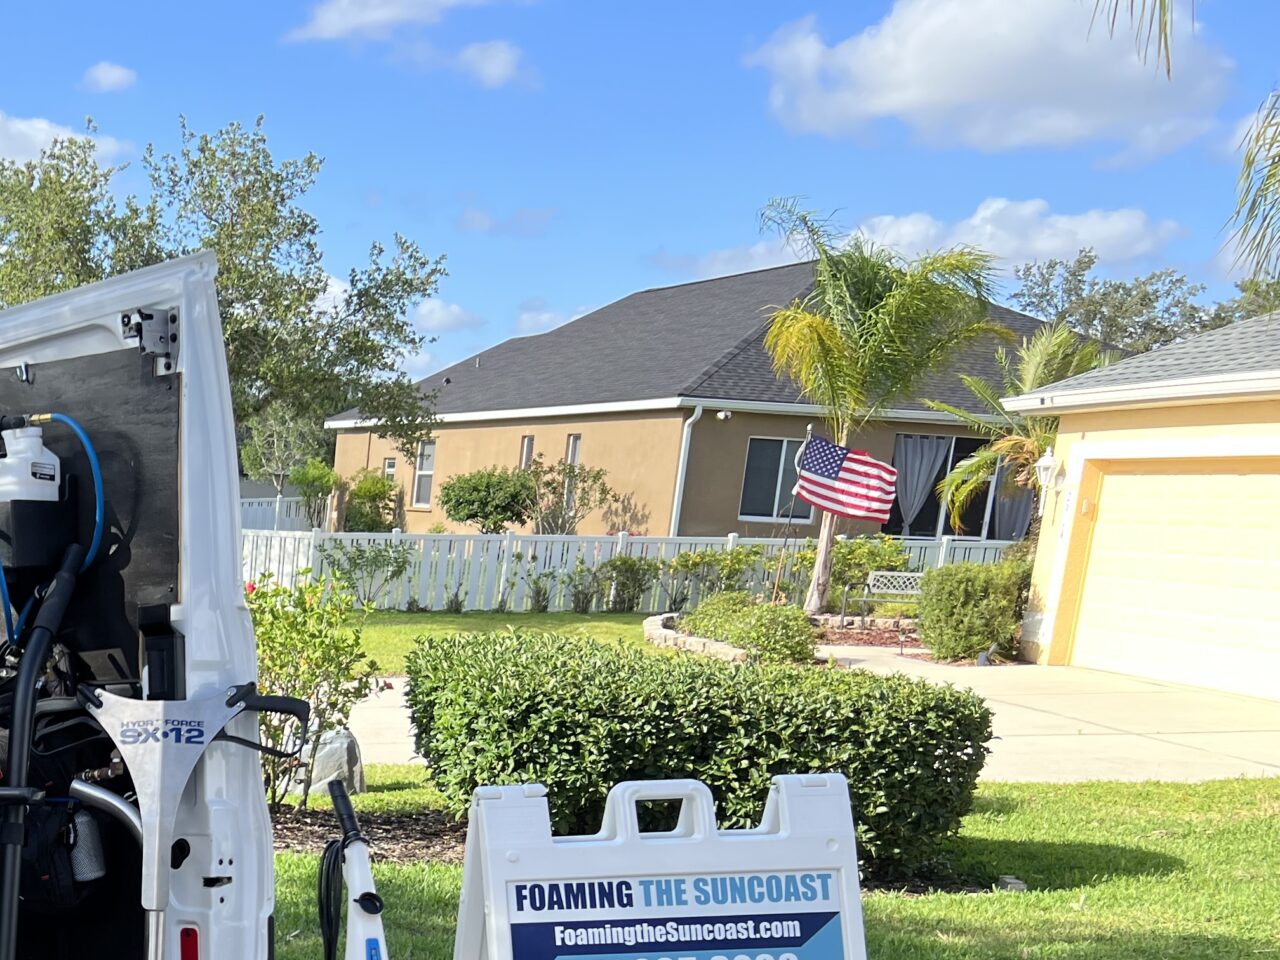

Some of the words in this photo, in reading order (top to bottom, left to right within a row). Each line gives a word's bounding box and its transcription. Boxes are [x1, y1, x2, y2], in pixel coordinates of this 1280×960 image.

[515, 880, 634, 912] FOAMING
[639, 877, 688, 908] THE
[693, 873, 832, 905] SUNCOAST
[554, 920, 801, 946] FoamingtheSuncoast.com
